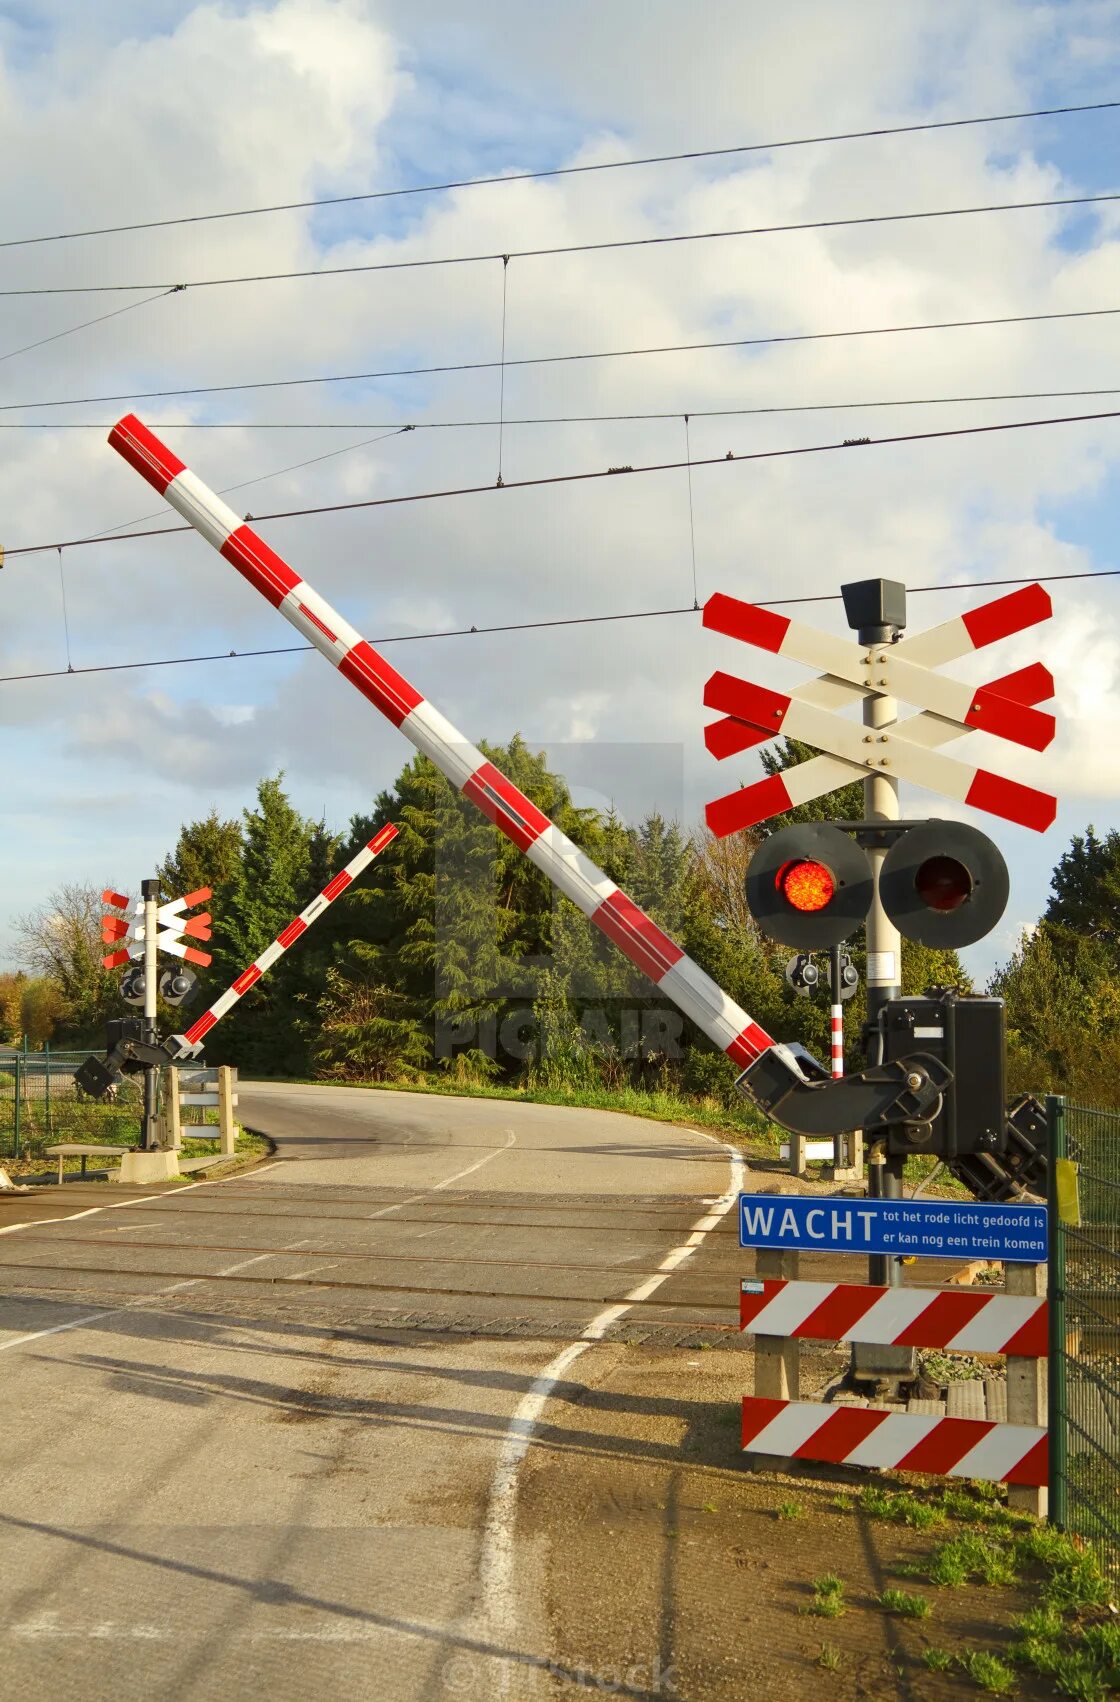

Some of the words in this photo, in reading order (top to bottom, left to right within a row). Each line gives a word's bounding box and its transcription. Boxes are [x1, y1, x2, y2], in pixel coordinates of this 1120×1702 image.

[743, 1206, 878, 1242] WACHT
[883, 1211, 899, 1222] tot
[903, 1211, 921, 1223] het
[925, 1212, 950, 1224] rode
[954, 1213, 979, 1225] licht
[982, 1215, 1030, 1228] gedoofd
[1034, 1217, 1044, 1228] is
[883, 1233, 895, 1243] er
[898, 1232, 918, 1244] kan
[922, 1235, 943, 1247] nog
[947, 1236, 968, 1246] een
[972, 1236, 1000, 1248] trein
[1004, 1237, 1044, 1250] komen
